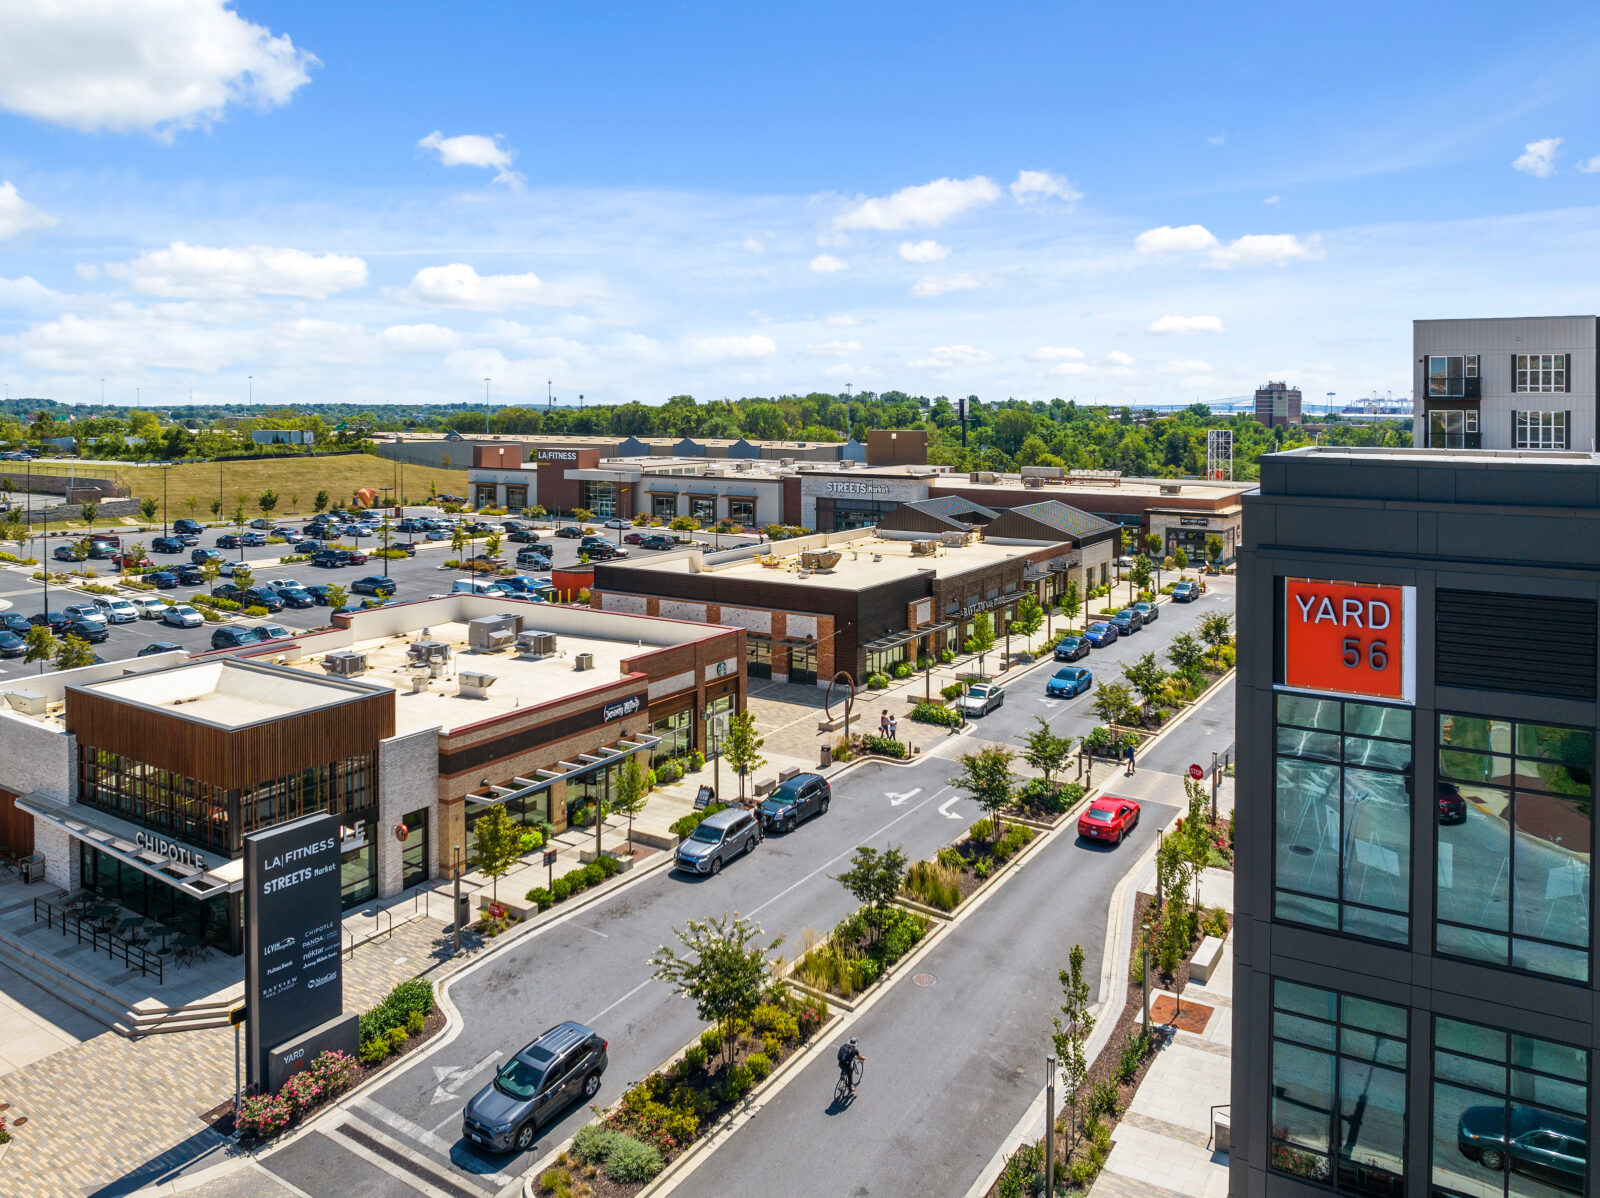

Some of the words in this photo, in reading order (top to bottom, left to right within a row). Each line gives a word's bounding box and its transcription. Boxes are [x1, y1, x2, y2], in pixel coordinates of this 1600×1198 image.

[548, 451, 577, 460] FITNESS
[827, 482, 867, 494] STREETS
[868, 485, 890, 494] Market
[1295, 595, 1391, 630] YARD
[1342, 638, 1388, 671] 56
[1190, 767, 1203, 777] STOP
[135, 831, 205, 871] CHIPOTLE
[285, 837, 335, 864] FITNESS
[263, 867, 312, 895] STREETS
[313, 862, 336, 877] Market
[304, 921, 334, 938] CHIPOTLE
[302, 935, 324, 949] PANDA
[283, 1048, 305, 1065] YARD
